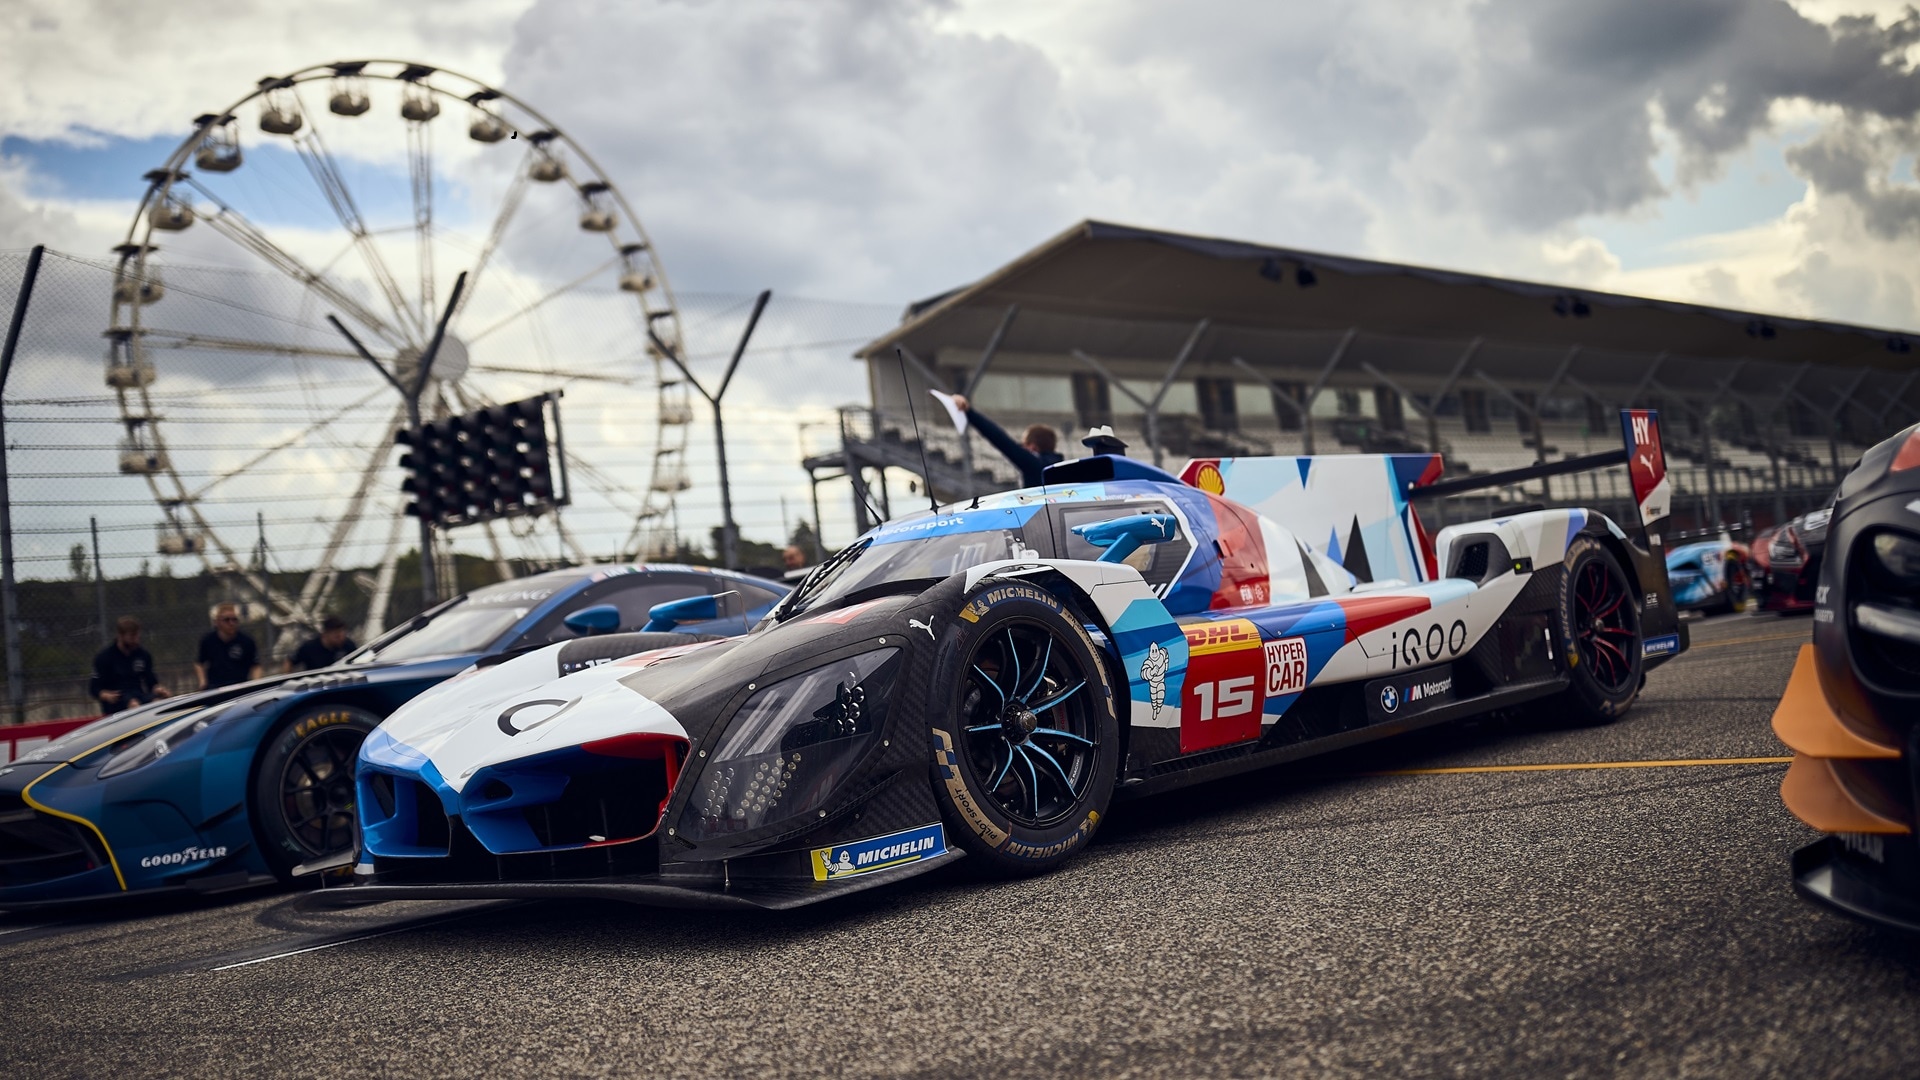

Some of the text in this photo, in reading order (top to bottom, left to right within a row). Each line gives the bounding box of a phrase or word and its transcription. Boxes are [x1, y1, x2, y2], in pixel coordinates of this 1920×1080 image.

[1631, 416, 1650, 445] HY
[987, 588, 1057, 609] MICHELIN
[1184, 624, 1260, 647] DHL
[1266, 642, 1304, 664] HYPER
[1269, 661, 1305, 692] CAR
[1423, 676, 1452, 698] Motorsport
[1194, 675, 1256, 721] 15
[295, 711, 351, 737] EAGLE
[954, 787, 998, 840] PILOT SPORT
[141, 847, 228, 868] GOODYEAR
[857, 836, 935, 865] MICHELIN
[1007, 832, 1080, 859] MICHELIN
